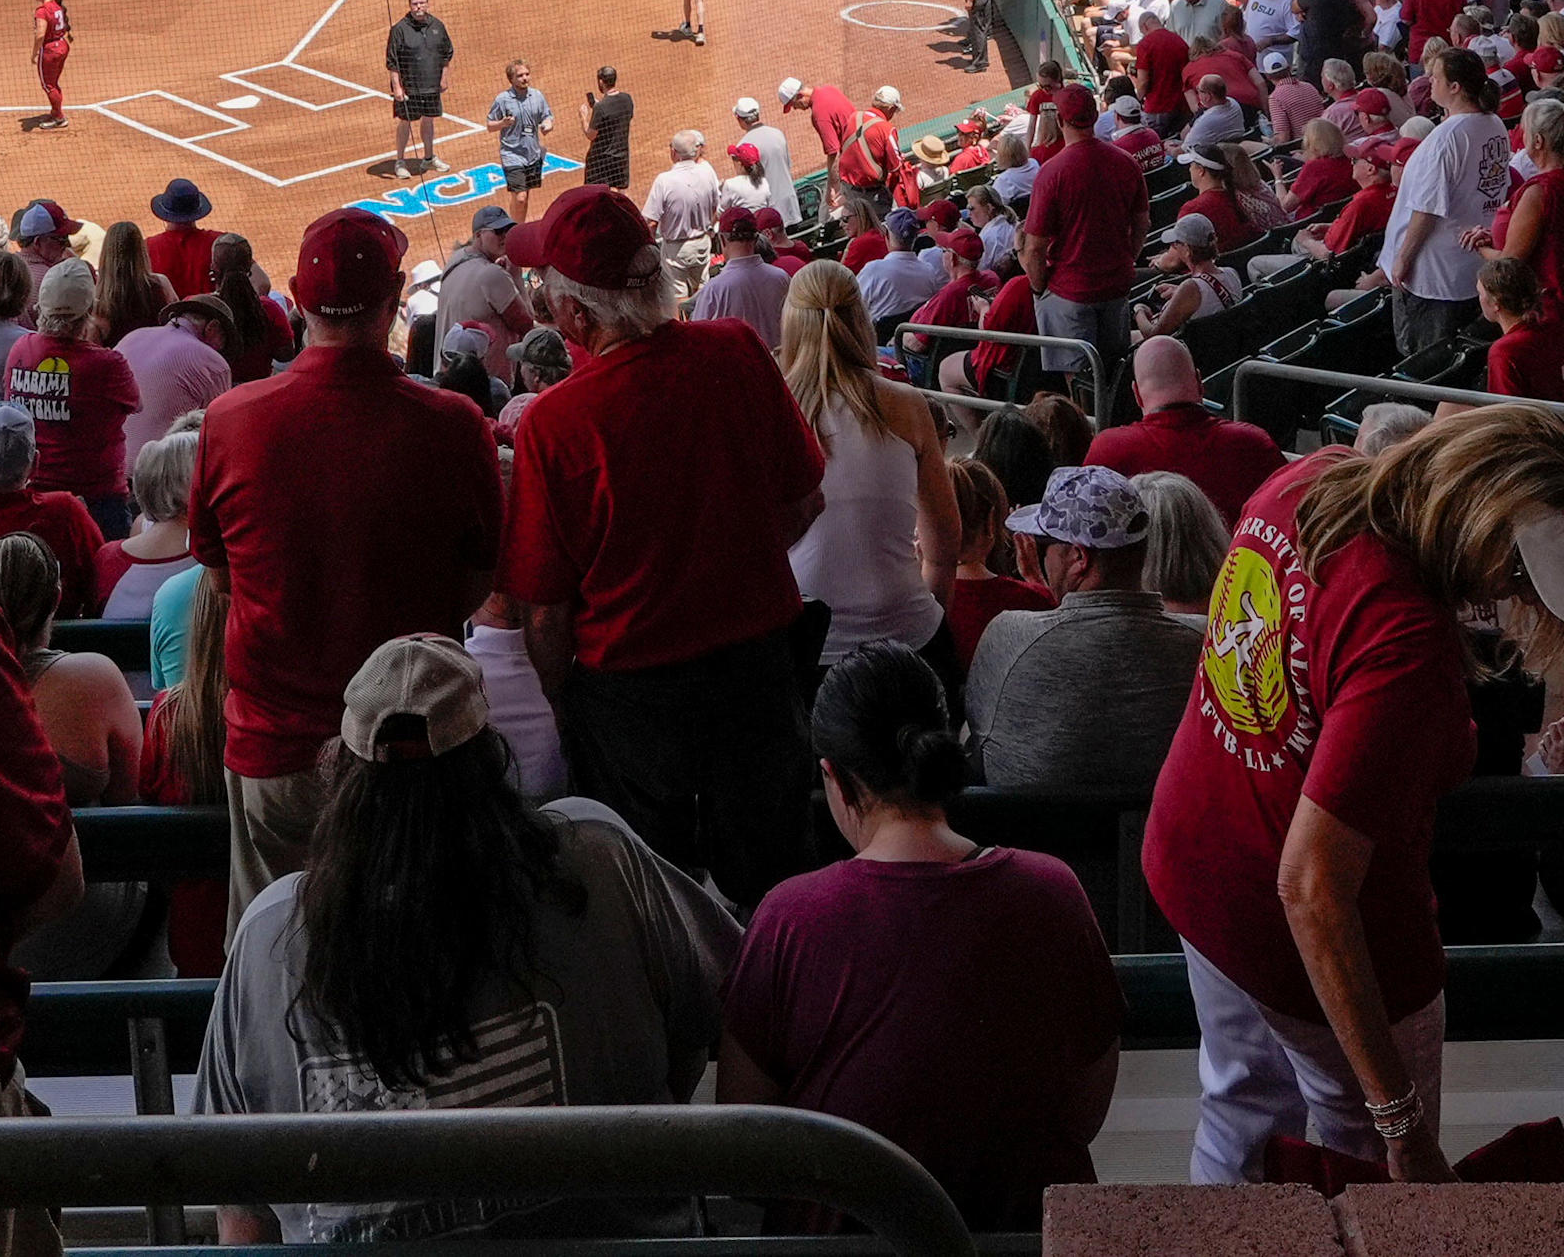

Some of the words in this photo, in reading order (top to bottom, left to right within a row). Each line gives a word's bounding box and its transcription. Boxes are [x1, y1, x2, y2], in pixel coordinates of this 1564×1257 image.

[1257, 4, 1276, 16] SLU
[320, 303, 365, 316] SOFTBALL
[9, 367, 71, 397] ALABAMA
[1288, 582, 1307, 623] OF
